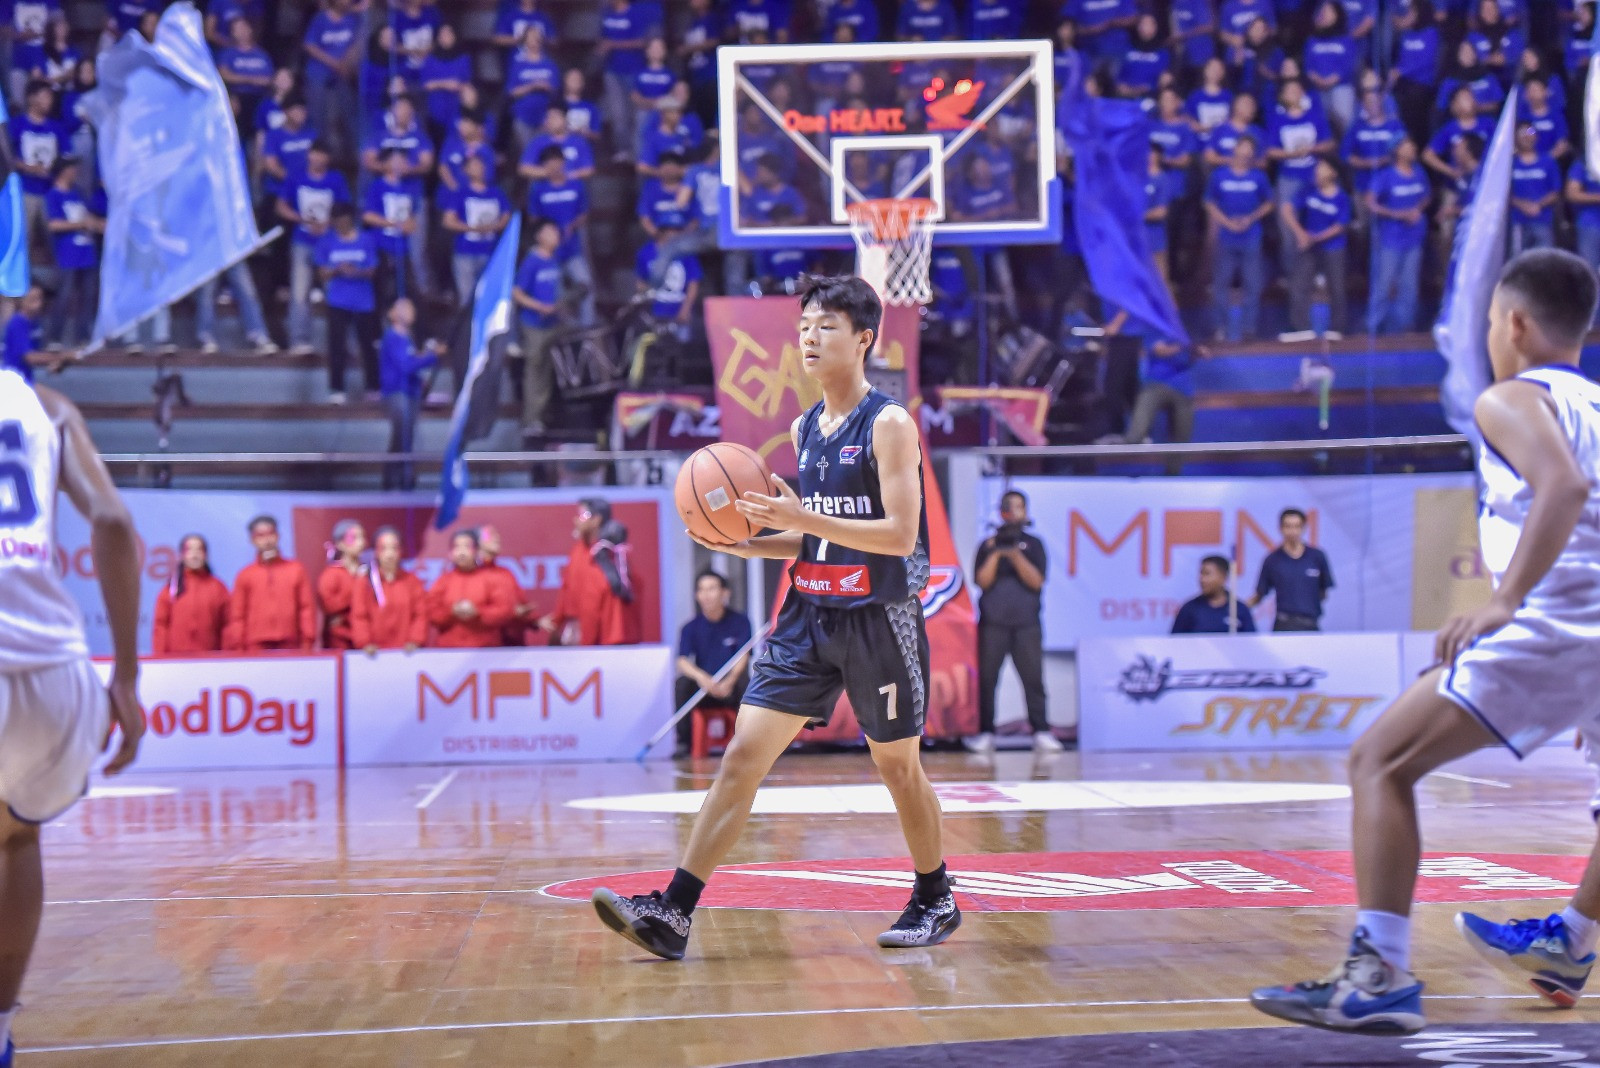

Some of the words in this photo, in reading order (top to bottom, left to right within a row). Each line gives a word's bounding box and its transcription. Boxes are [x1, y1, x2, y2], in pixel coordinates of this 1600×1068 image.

[784, 109, 826, 133] One
[795, 575, 809, 588] One
[418, 669, 601, 721] MPM
[878, 682, 898, 721] 7
[1170, 693, 1383, 736] STREET
[220, 687, 315, 745] Day
[442, 734, 578, 752] DISTRIBUTOR
